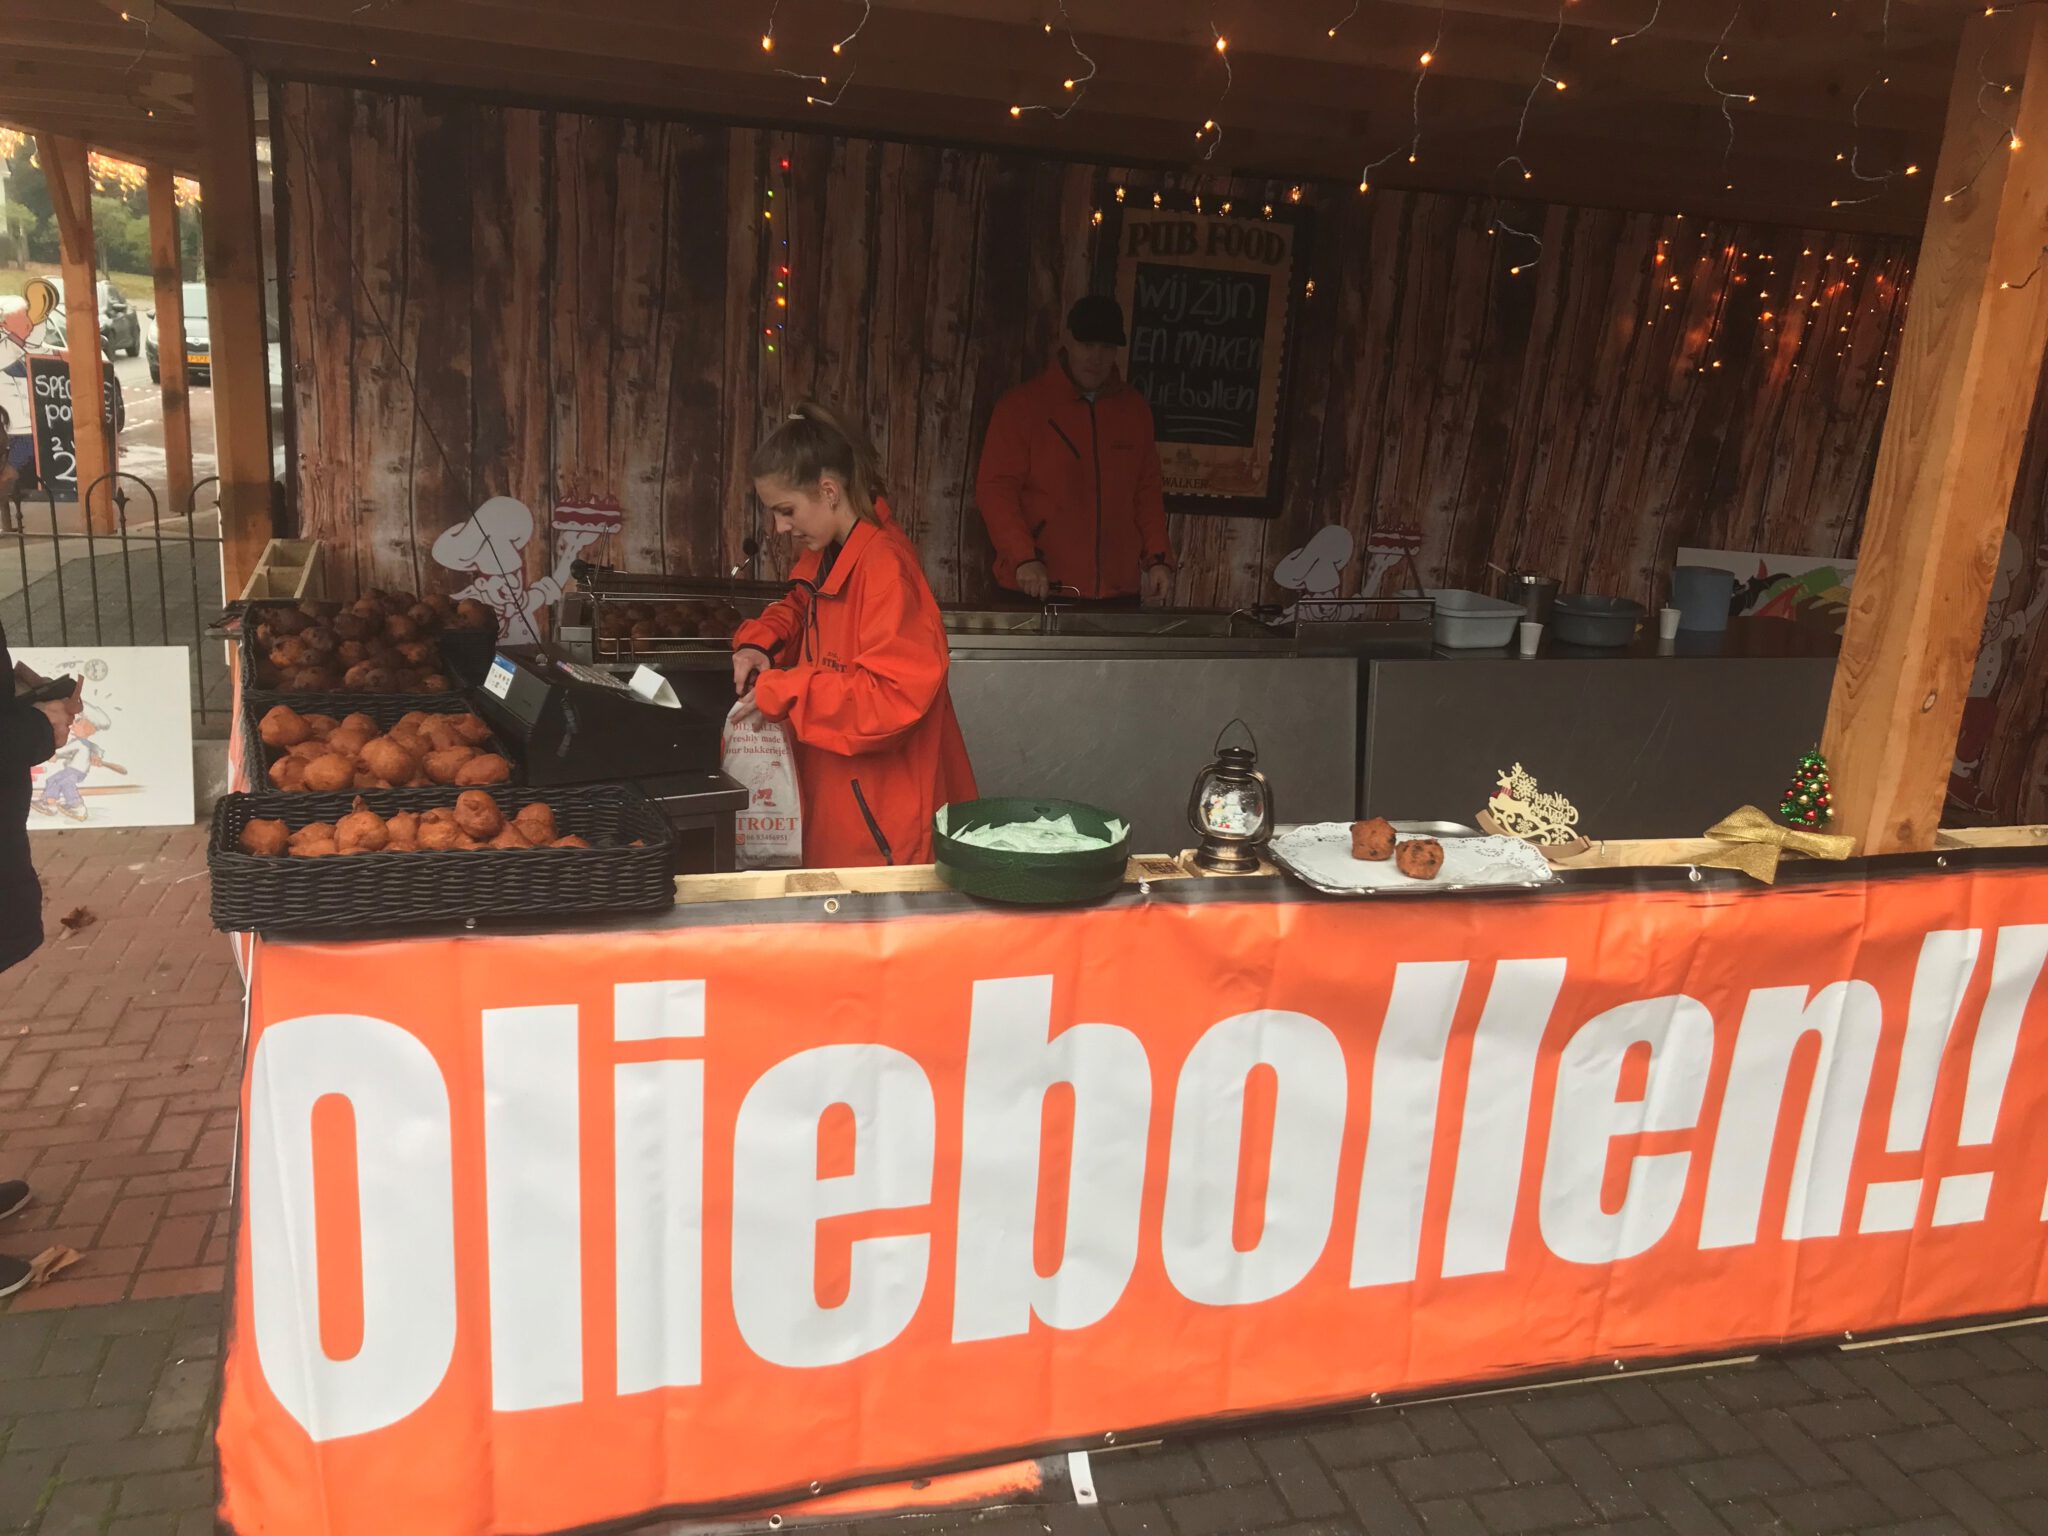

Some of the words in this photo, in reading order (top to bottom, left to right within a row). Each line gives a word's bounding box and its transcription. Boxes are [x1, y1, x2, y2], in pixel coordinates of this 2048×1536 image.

[1126, 220, 1198, 257] PUB
[1205, 222, 1285, 266] FOOD
[1161, 476, 1209, 489] WALKER
[736, 817, 800, 831] TROET
